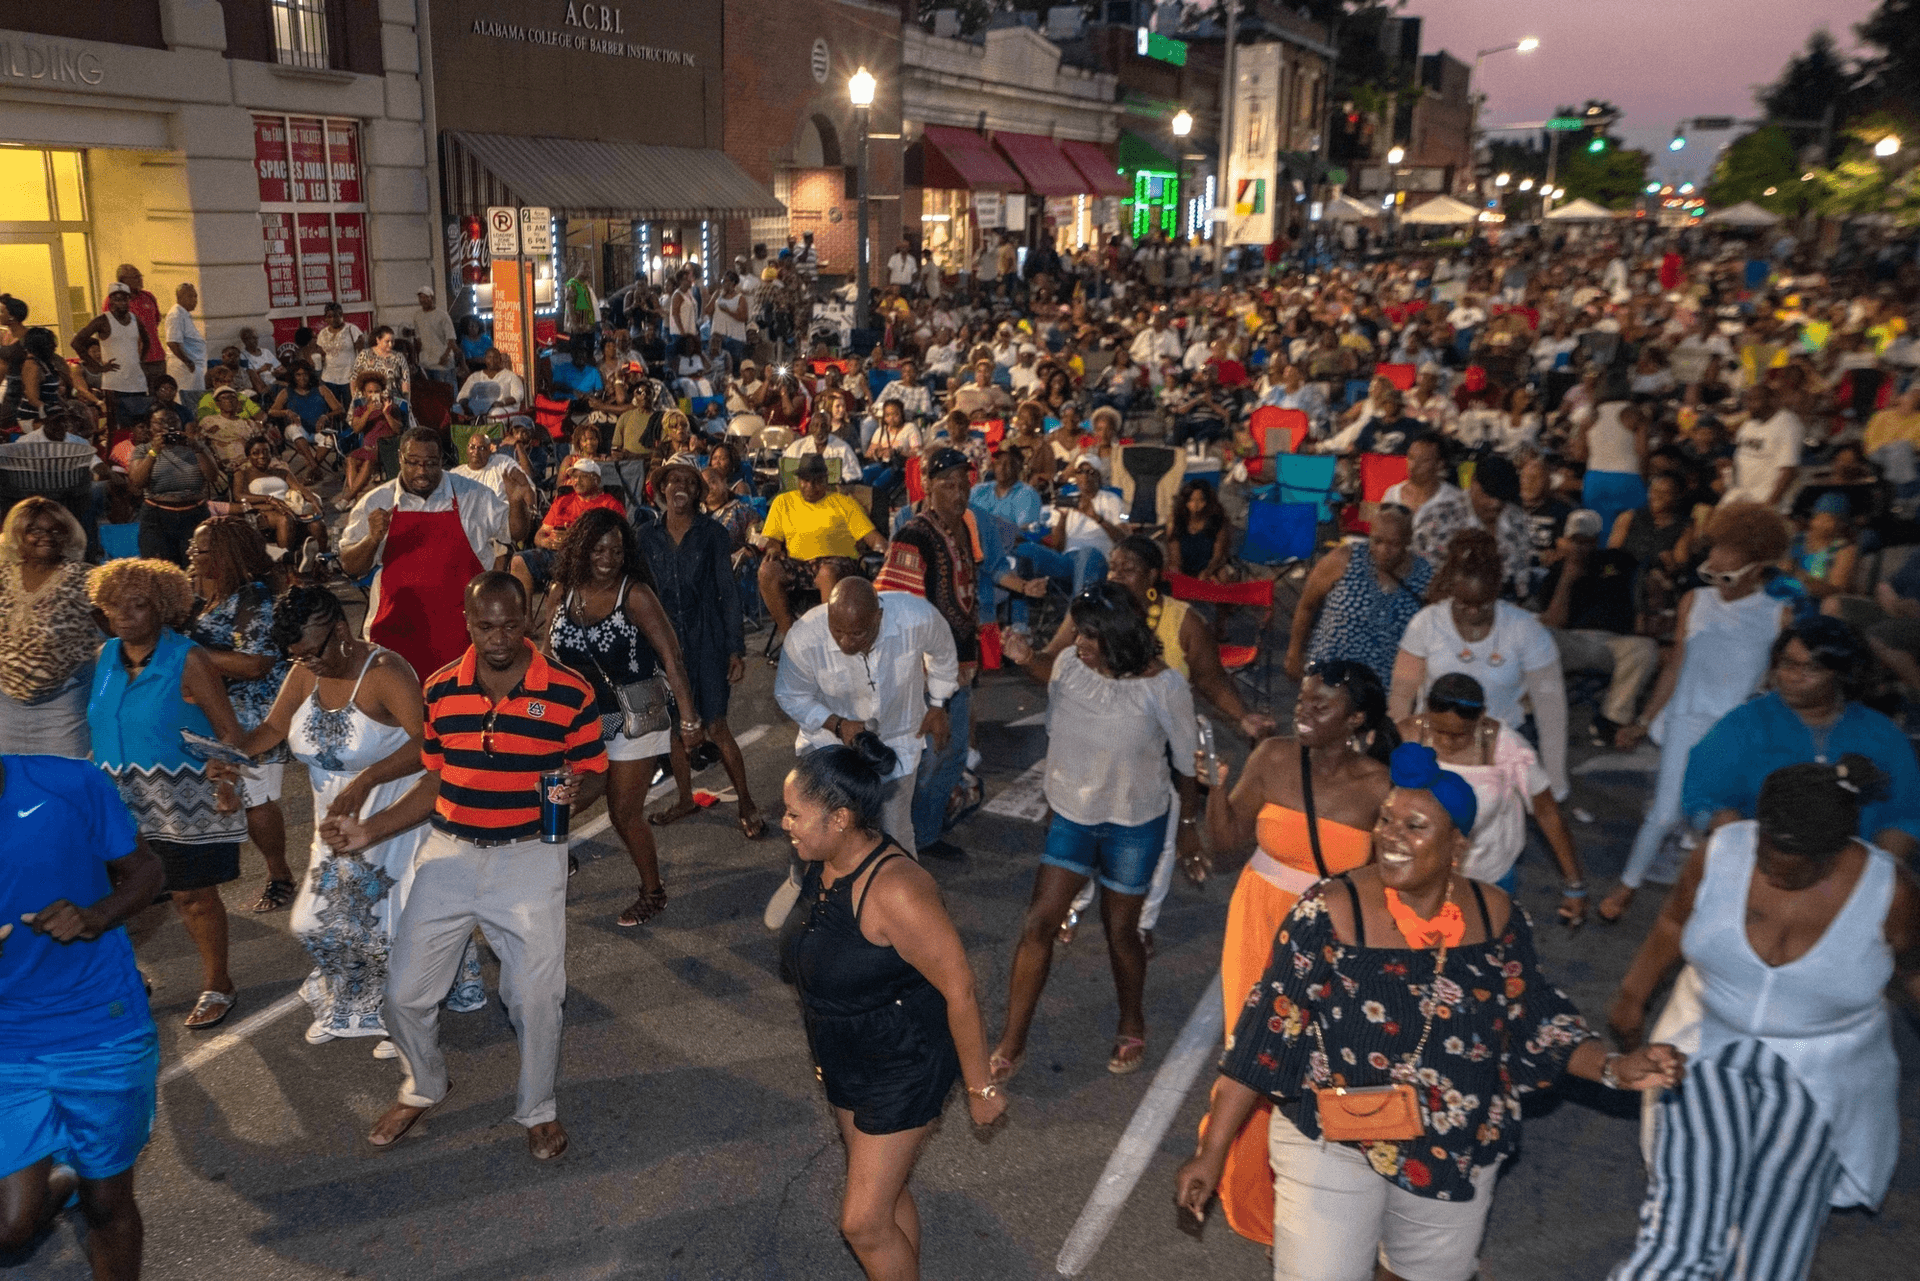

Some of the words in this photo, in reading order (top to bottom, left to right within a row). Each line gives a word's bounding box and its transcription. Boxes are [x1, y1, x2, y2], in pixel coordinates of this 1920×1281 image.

[565, 1, 624, 35] A.C.B.I.
[472, 19, 525, 41] ALABAMA
[528, 28, 572, 48] COLLEGE
[574, 35, 588, 50] OF
[589, 38, 624, 57] BARBER
[627, 44, 681, 65] INSTRUCTION
[303, 162, 356, 180] AVAIABLE
[310, 182, 342, 201] LEASE
[494, 301, 521, 312] ADAPTIV
